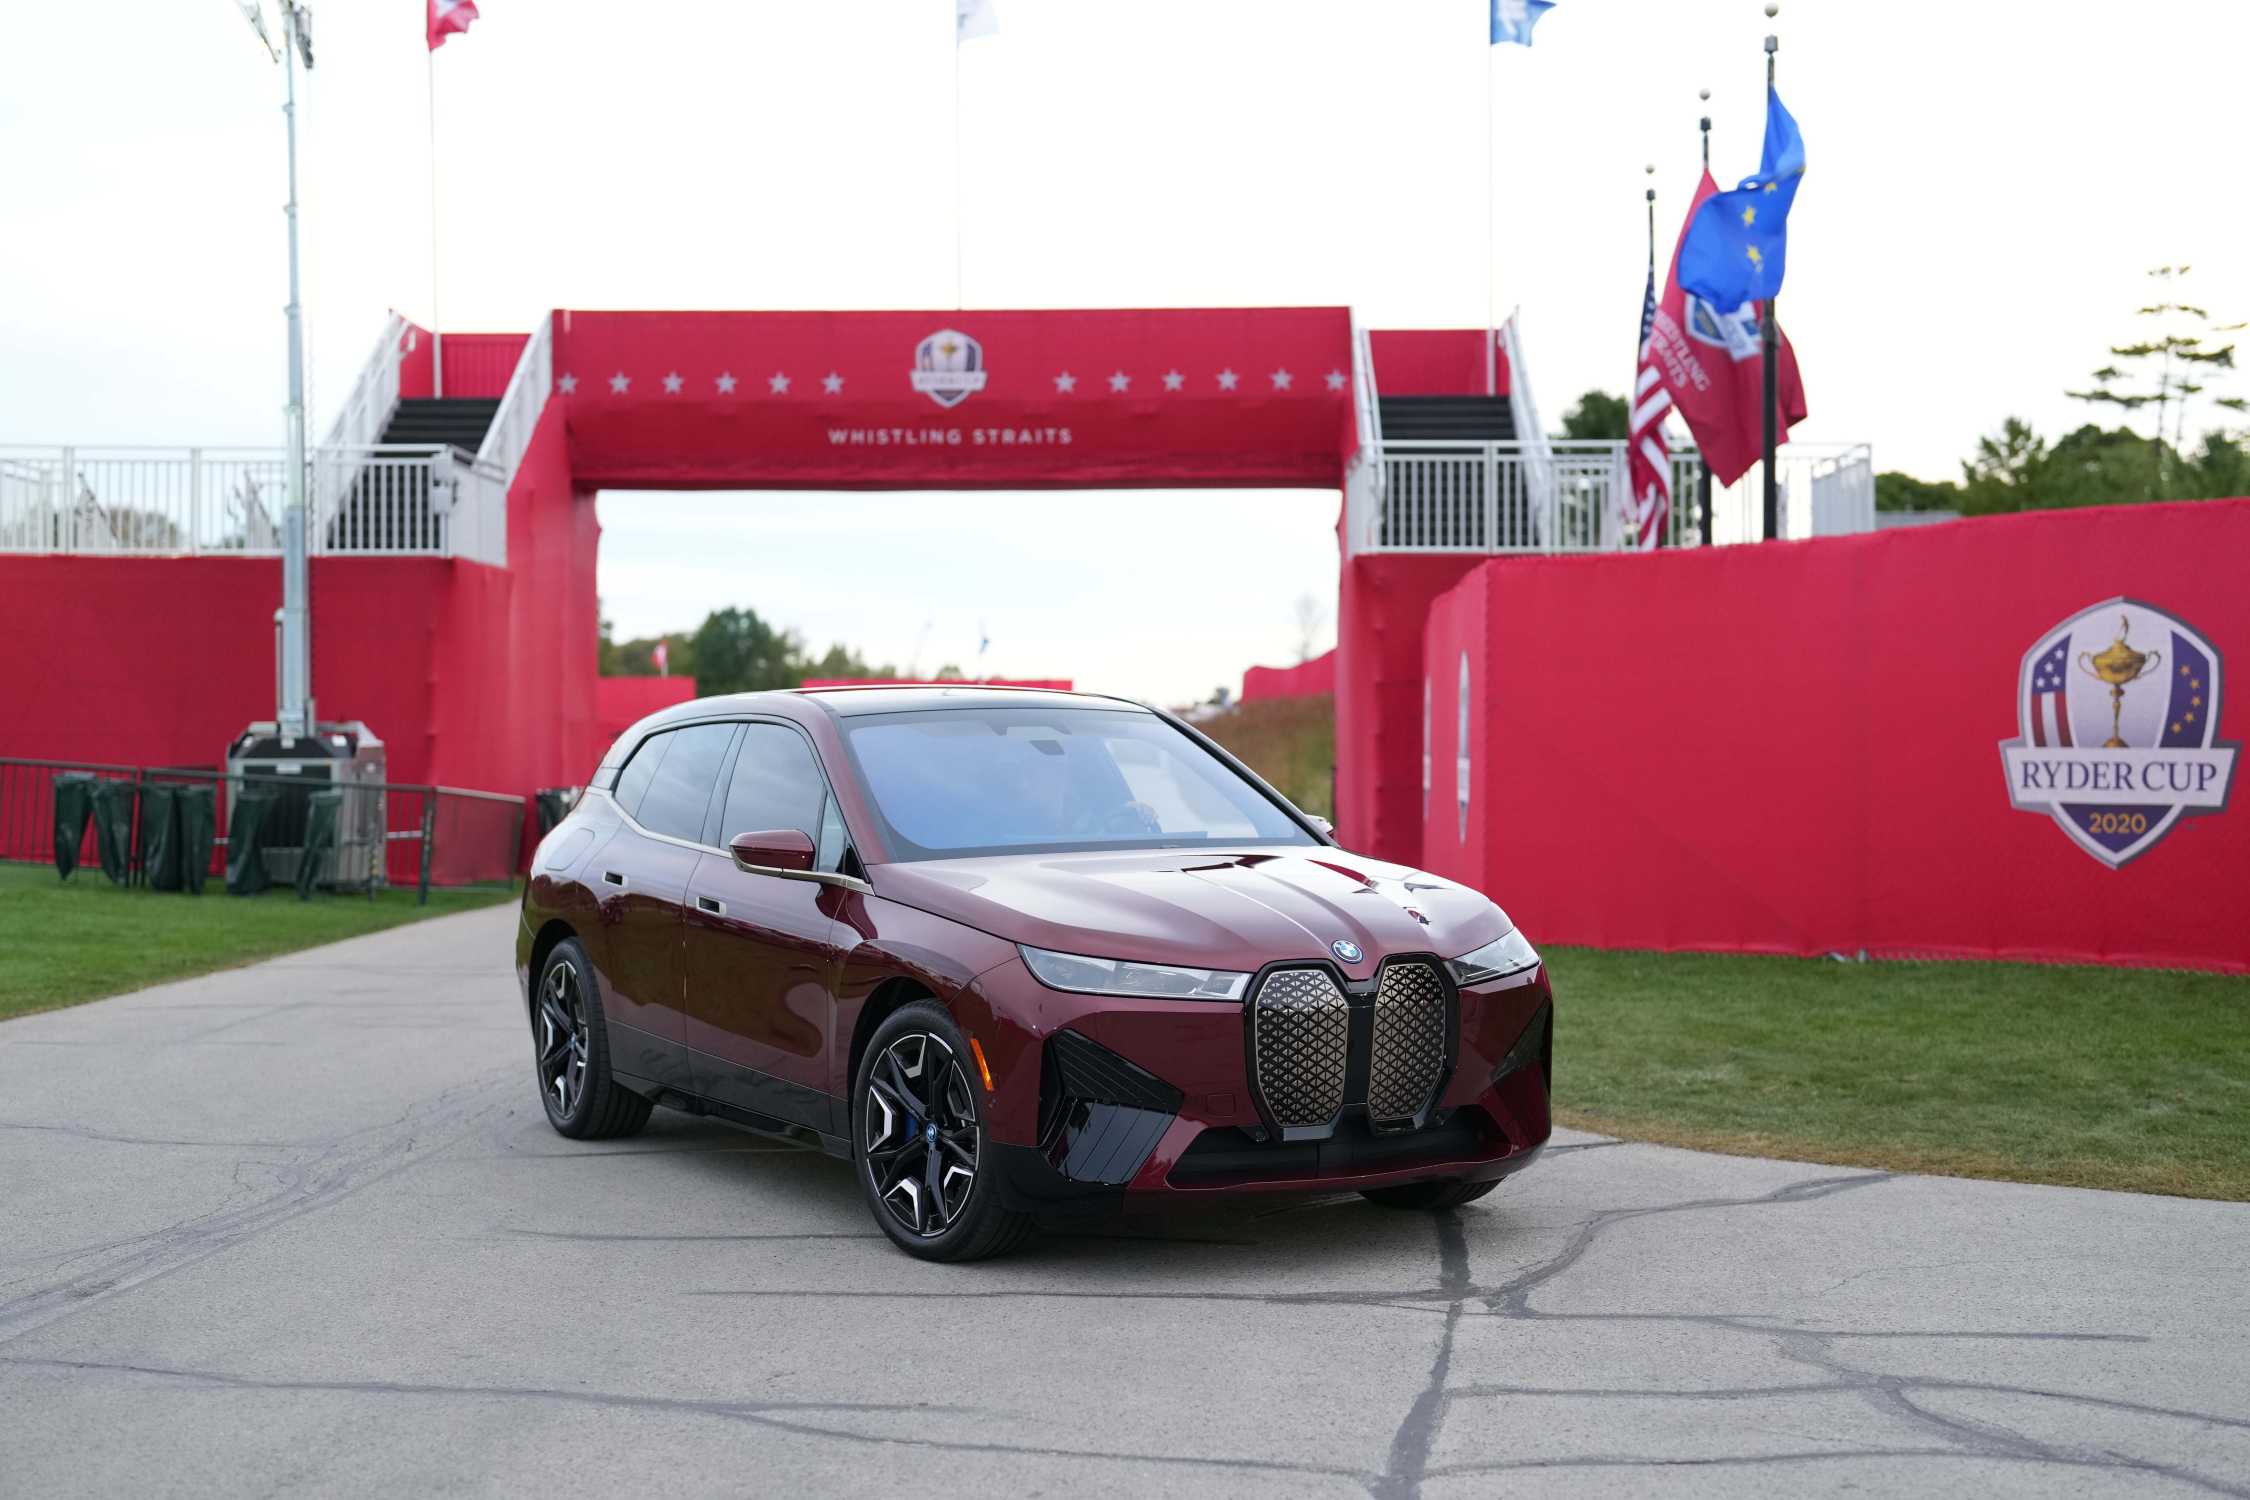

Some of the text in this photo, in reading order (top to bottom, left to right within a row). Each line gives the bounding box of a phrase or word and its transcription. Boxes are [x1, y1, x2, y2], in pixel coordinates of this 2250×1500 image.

[827, 427, 1072, 445] WHISTLING STRAITS
[2021, 760, 2217, 792] RYDER CUP
[2089, 812, 2147, 834] 2020
